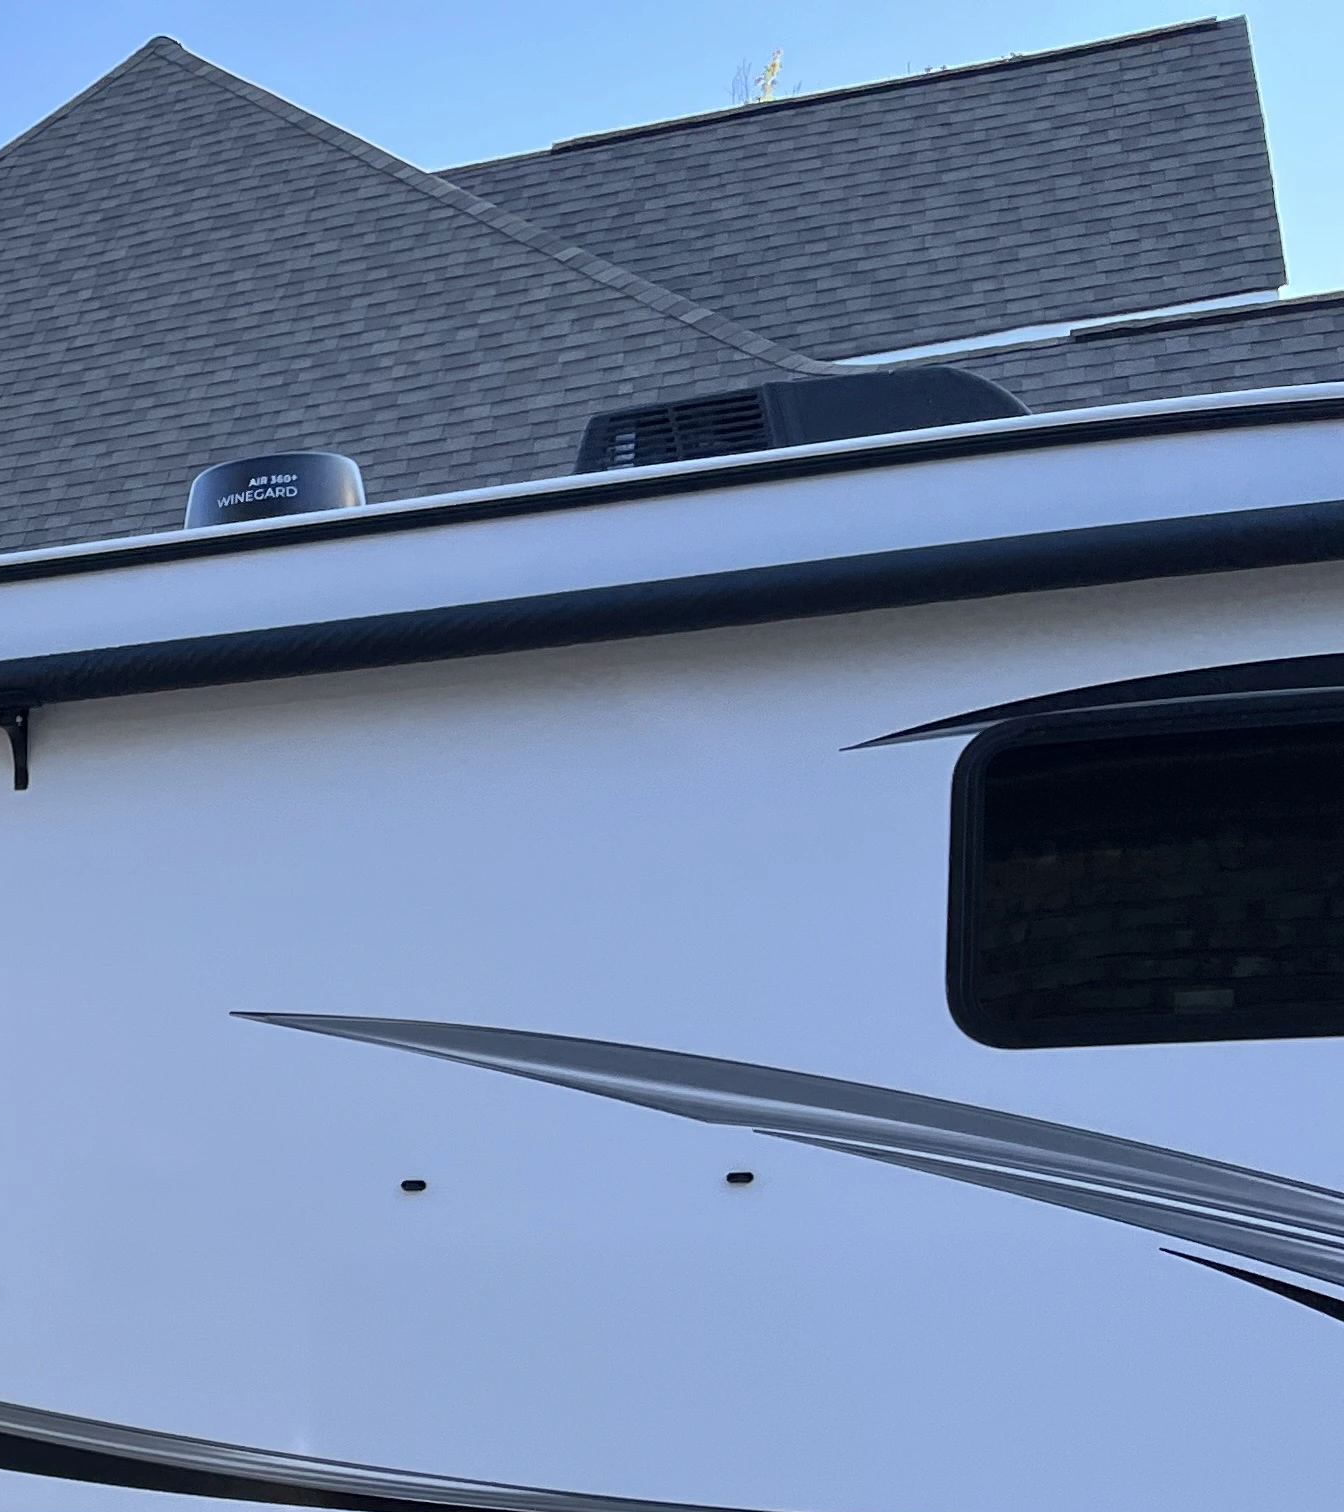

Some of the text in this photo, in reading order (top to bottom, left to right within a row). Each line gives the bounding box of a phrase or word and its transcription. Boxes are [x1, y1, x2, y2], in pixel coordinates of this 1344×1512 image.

[248, 474, 298, 487] AIR 360+
[217, 486, 298, 508] WINEGARD
